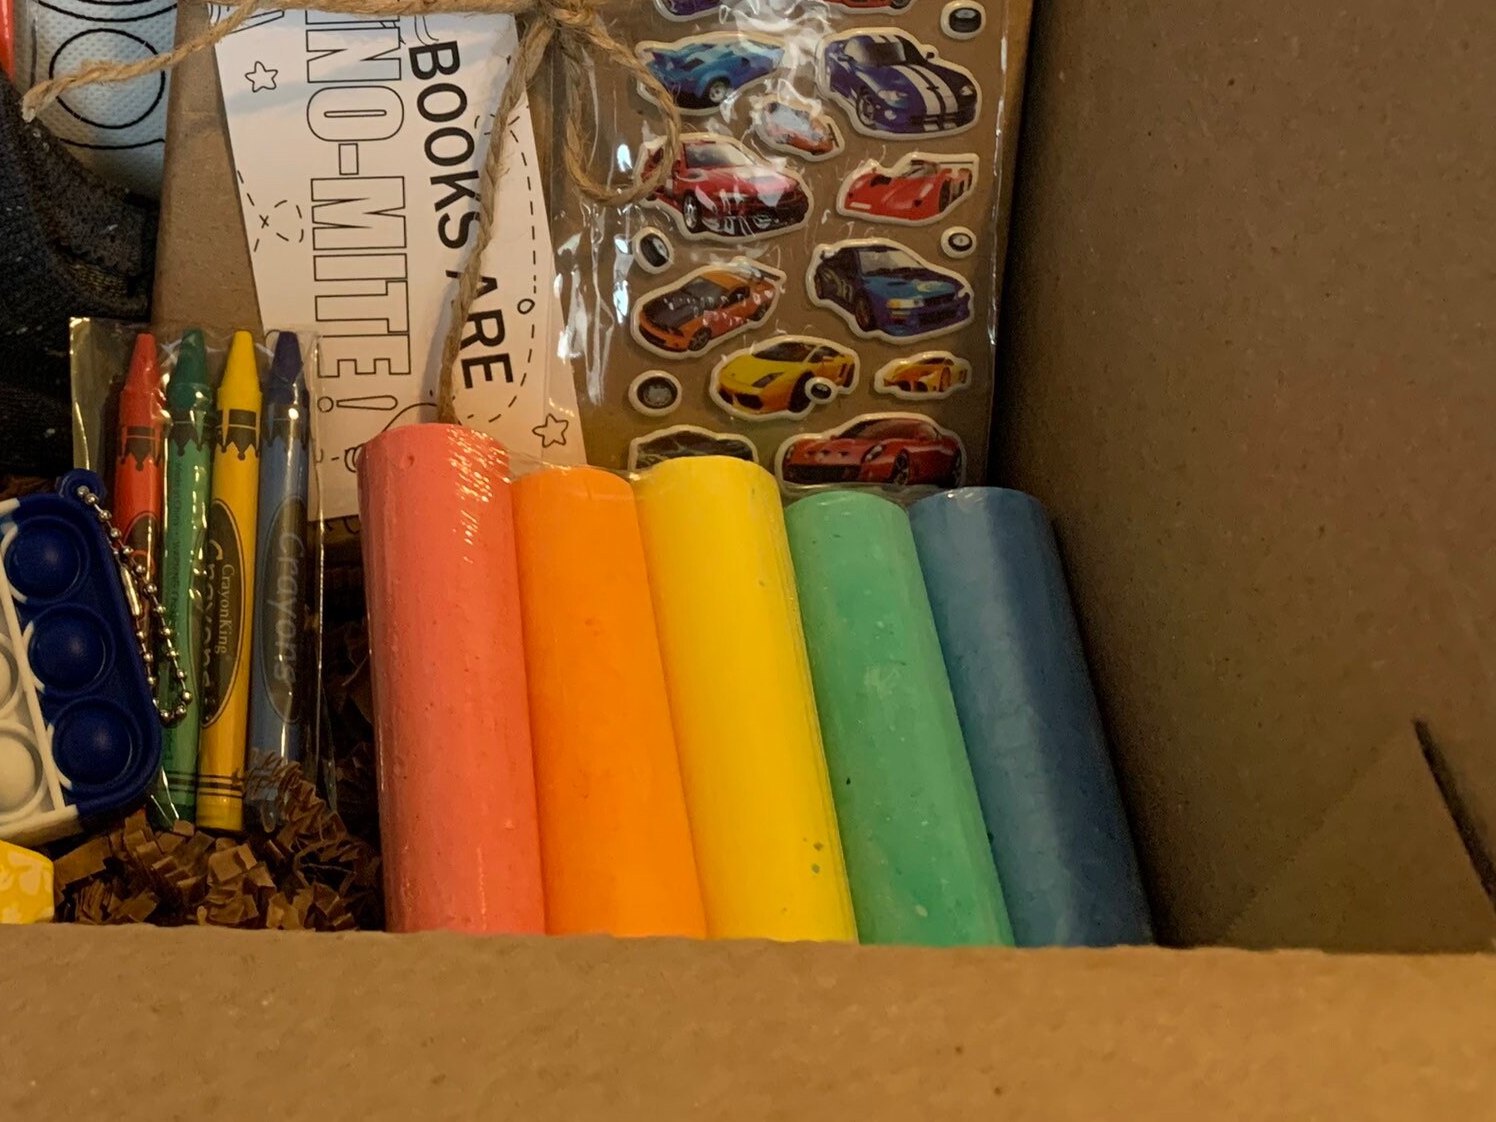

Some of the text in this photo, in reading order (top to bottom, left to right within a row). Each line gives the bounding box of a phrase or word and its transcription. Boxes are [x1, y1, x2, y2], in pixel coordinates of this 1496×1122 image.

[409, 41, 481, 250] BOOKS
[214, 563, 236, 654] CrayonKing
[266, 532, 305, 684] Crayons
